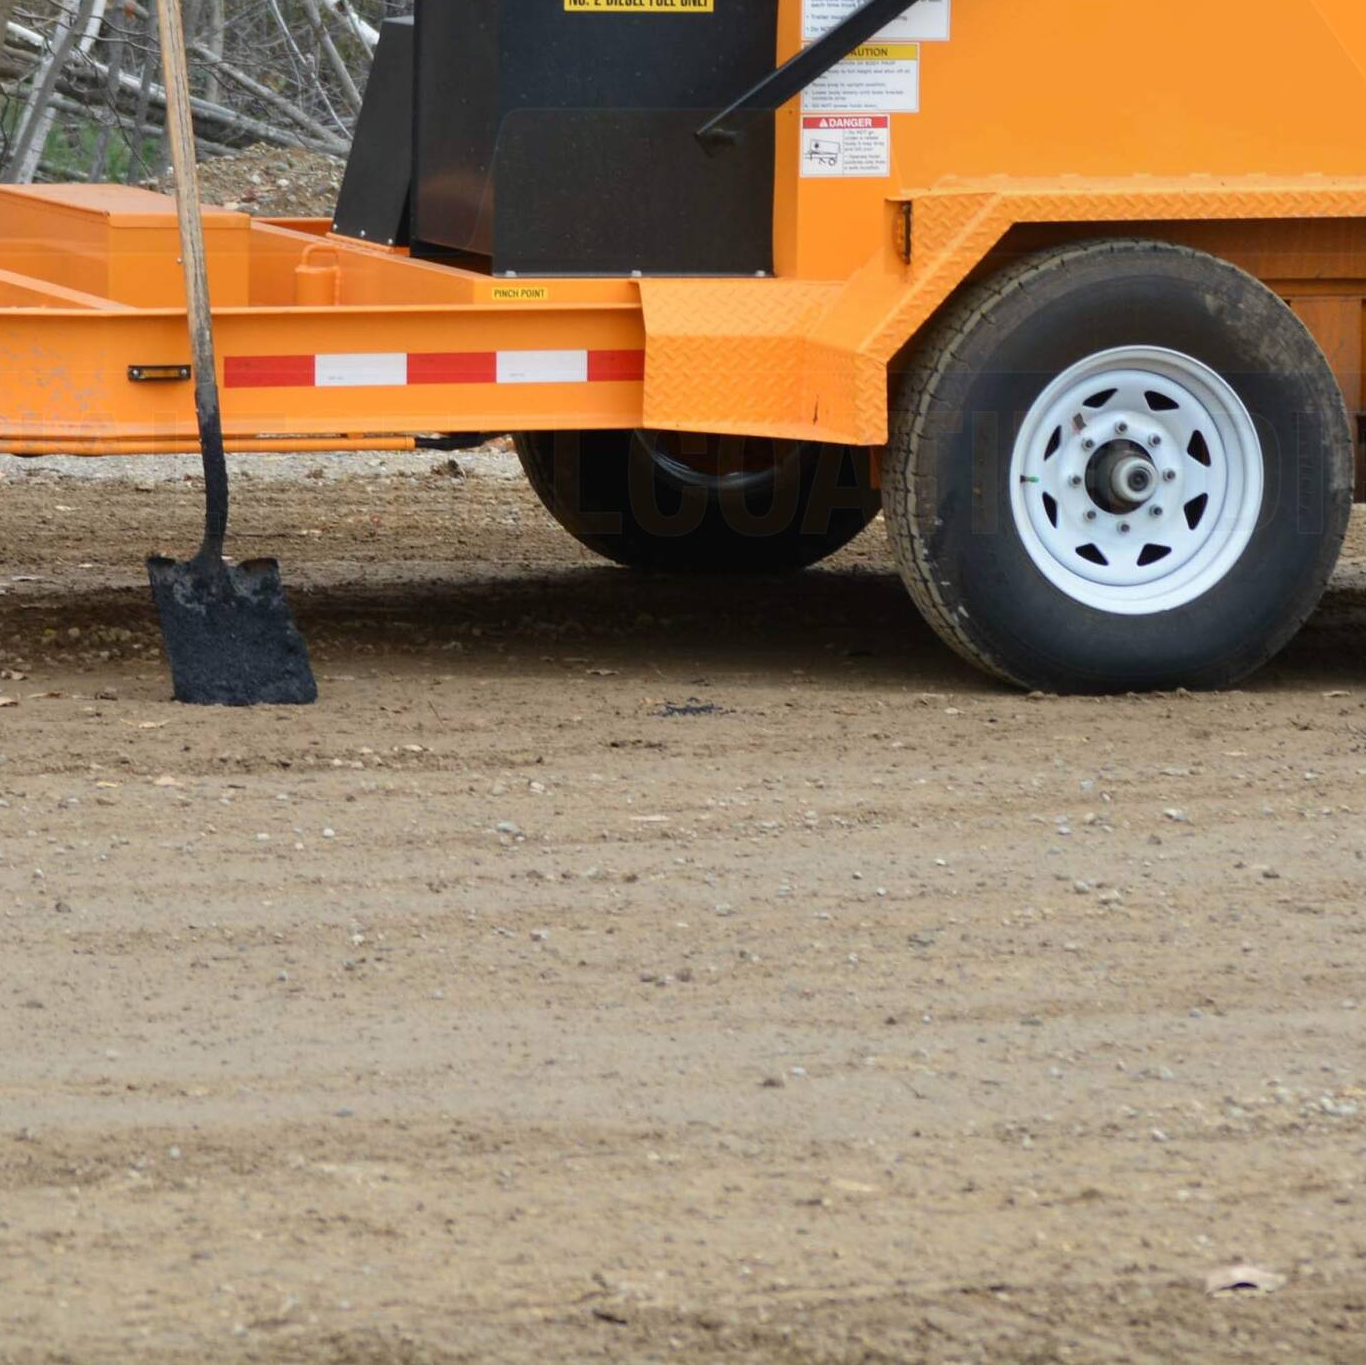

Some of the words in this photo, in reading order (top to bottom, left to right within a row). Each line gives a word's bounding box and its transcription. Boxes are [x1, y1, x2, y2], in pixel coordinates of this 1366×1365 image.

[849, 47, 889, 57] AUTION
[828, 118, 873, 128] DANGER
[494, 289, 519, 298] PINCH
[521, 289, 545, 299] POINT
